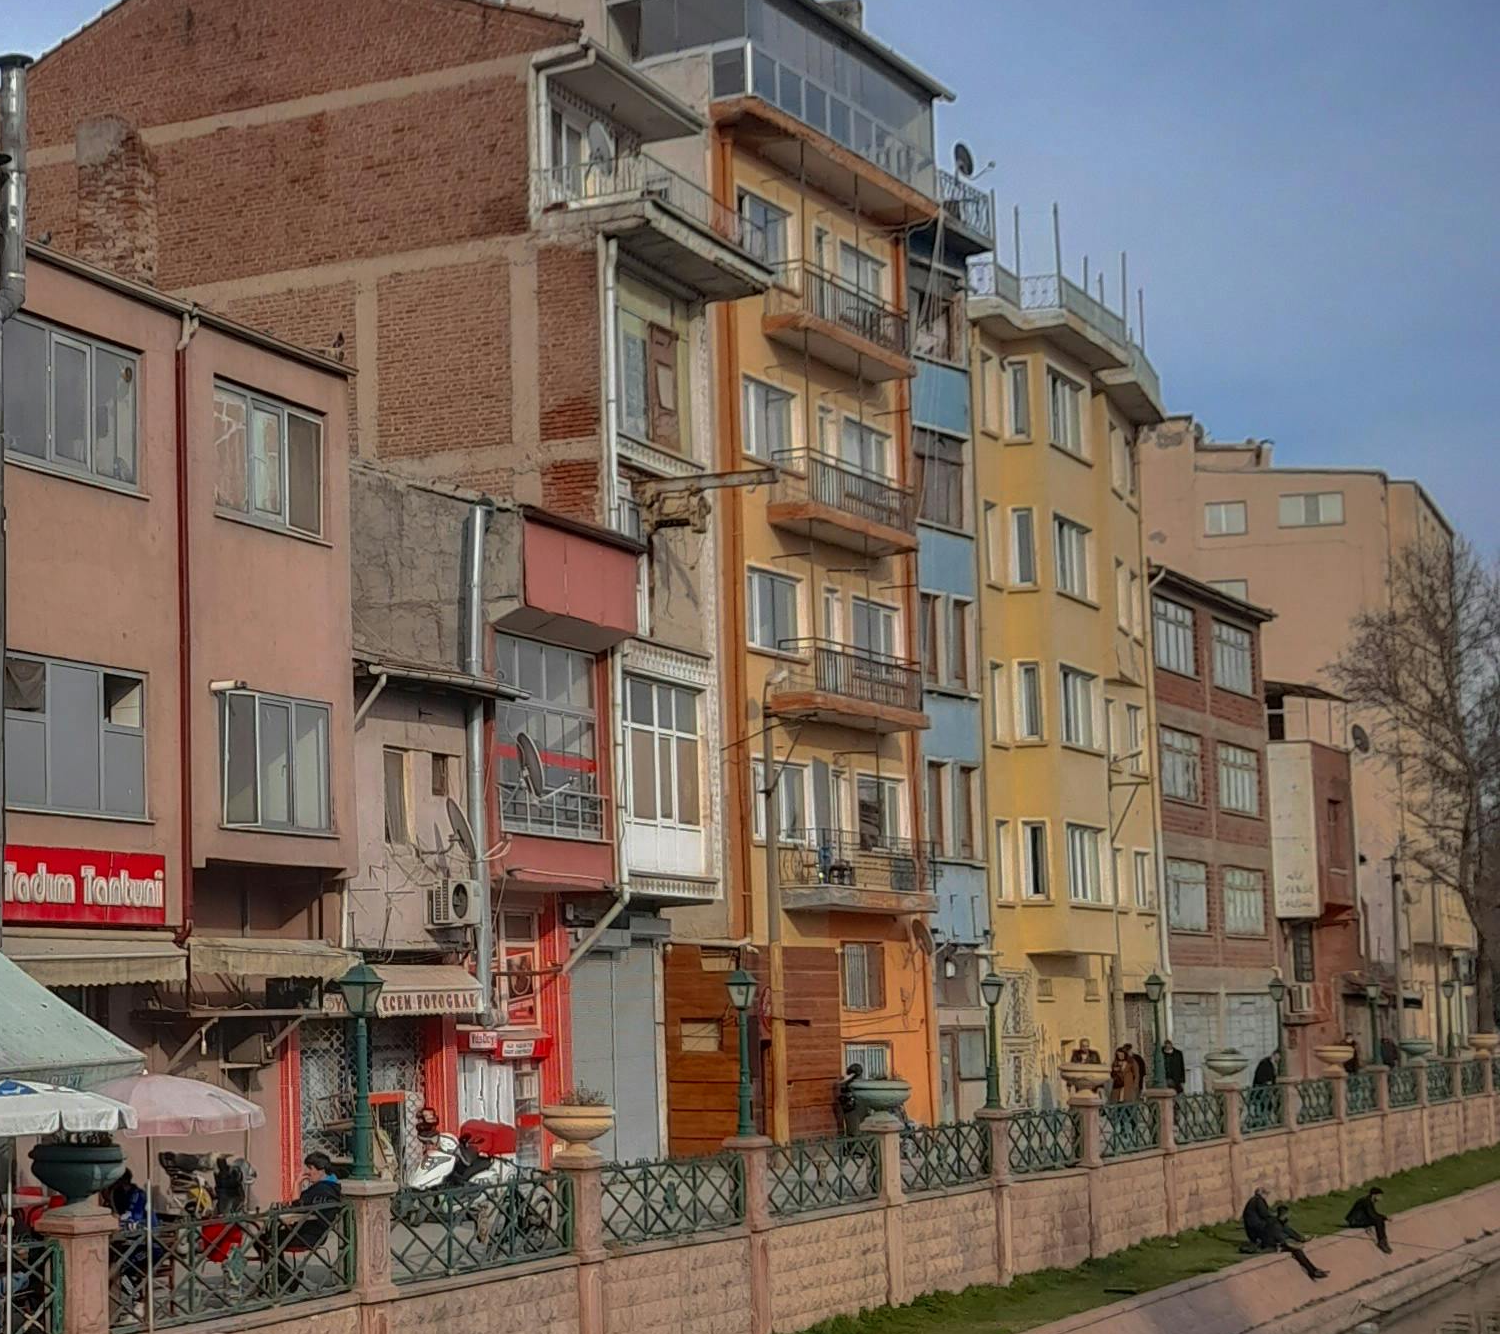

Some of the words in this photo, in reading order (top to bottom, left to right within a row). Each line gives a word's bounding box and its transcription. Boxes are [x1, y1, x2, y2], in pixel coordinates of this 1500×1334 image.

[3, 861, 76, 904] Tadım
[80, 865, 164, 908] Tantuni
[381, 994, 413, 1012] ECEM
